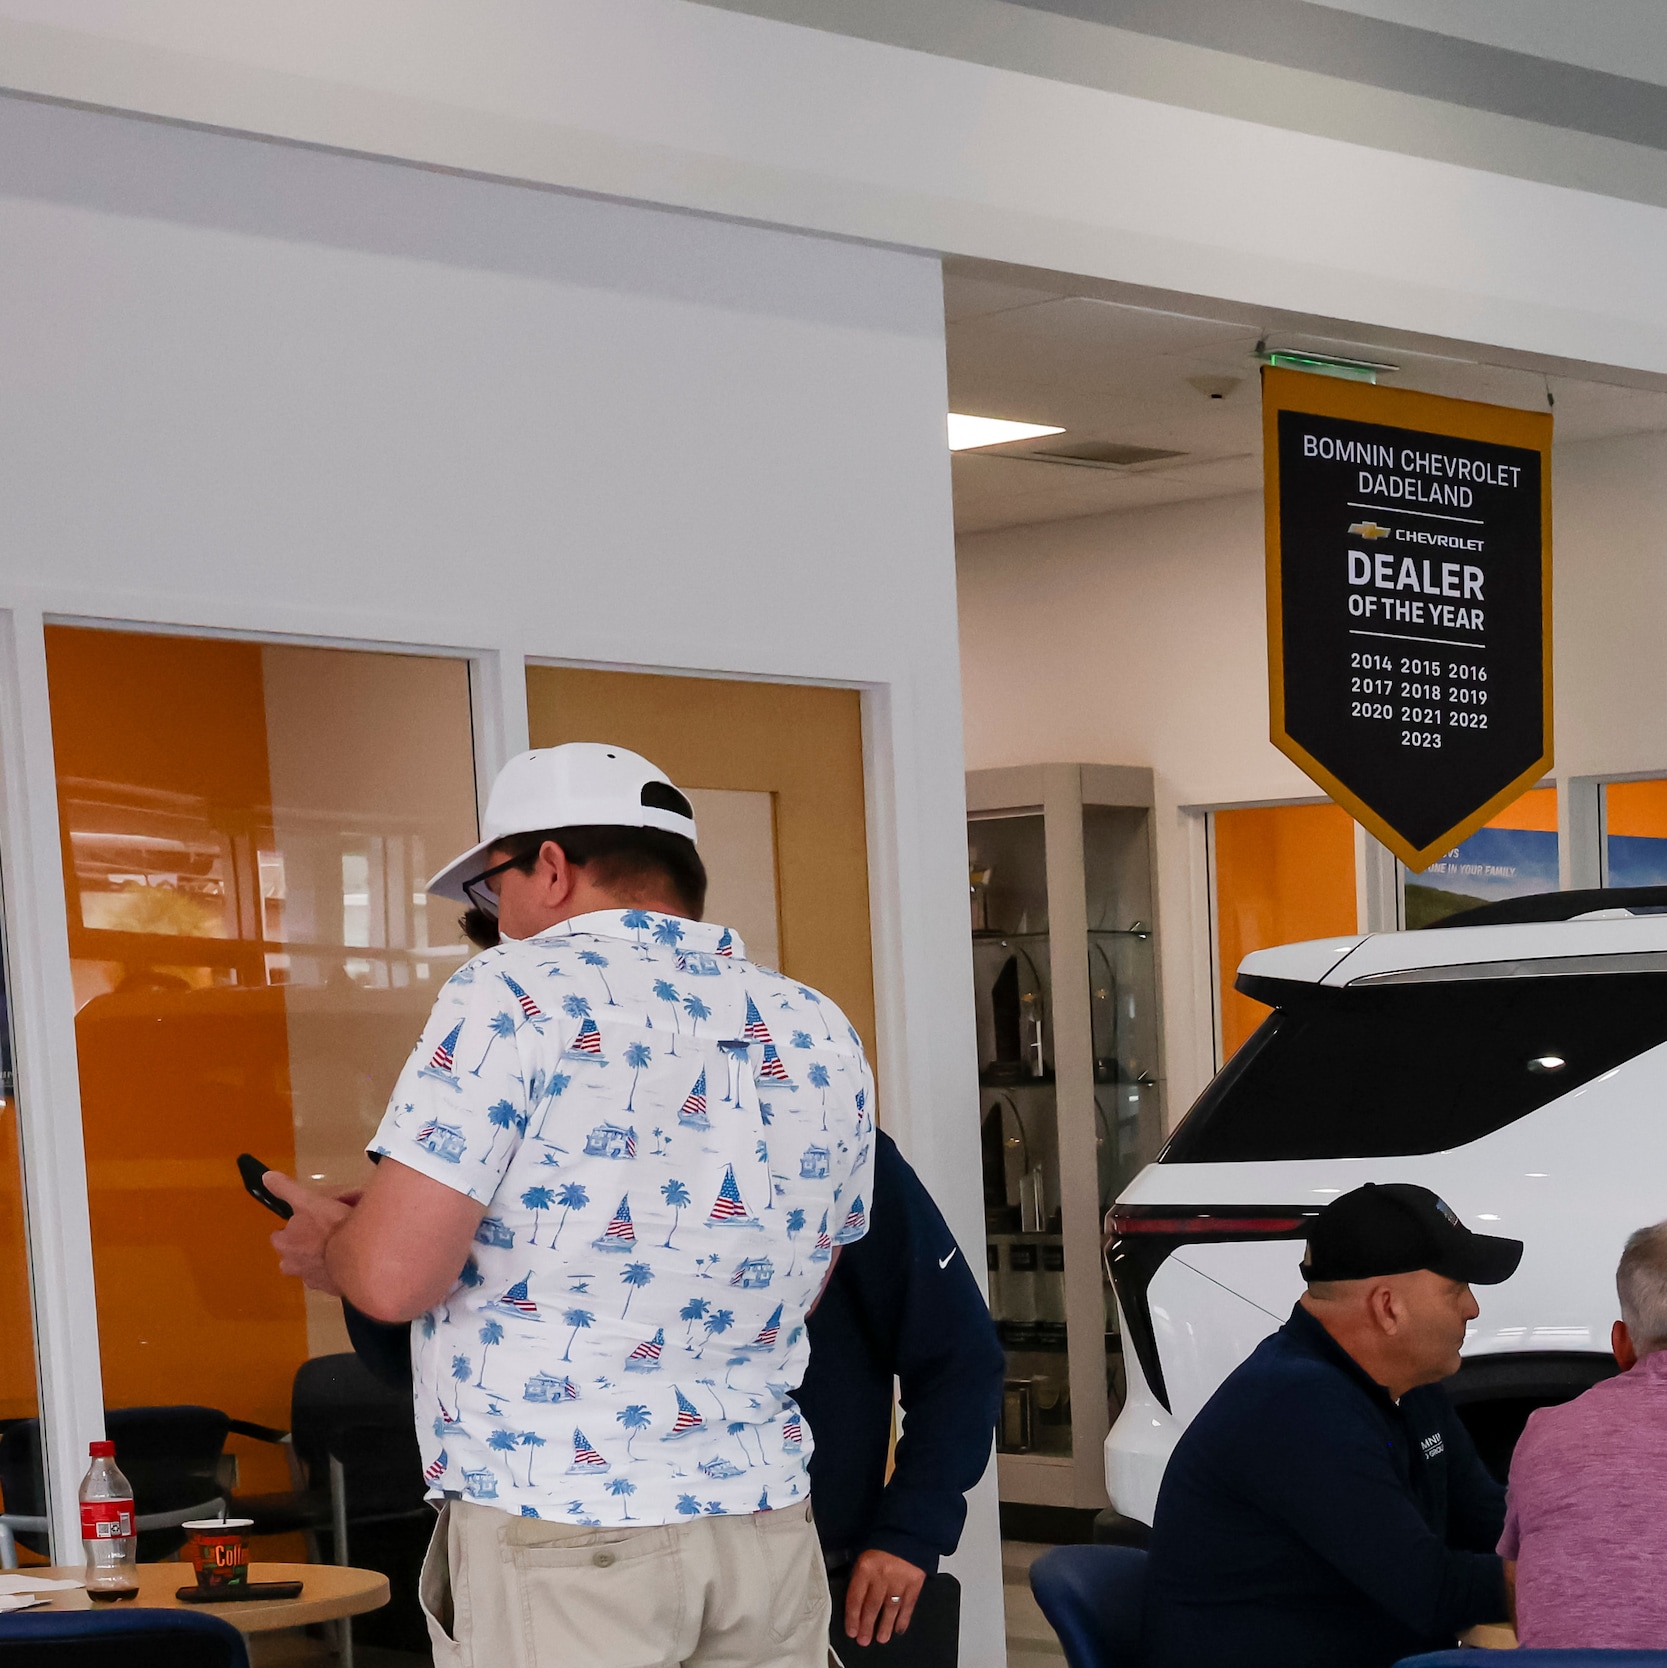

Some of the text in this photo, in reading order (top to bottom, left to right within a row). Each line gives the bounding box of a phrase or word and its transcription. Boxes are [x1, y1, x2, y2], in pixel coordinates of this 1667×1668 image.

[1303, 434, 1521, 488] BOMNIN CHEVROLET
[1358, 470, 1473, 508] DADELAND
[1395, 528, 1485, 552] CHEVROLET
[1347, 549, 1485, 601] DEALER
[1348, 594, 1485, 631] OF THE YEAR
[1350, 652, 1488, 682] 2014 2015 2016
[1351, 677, 1488, 706] 2017 2018 2019
[1351, 701, 1488, 729] 2020 2021 2022
[1401, 730, 1442, 749] 2023
